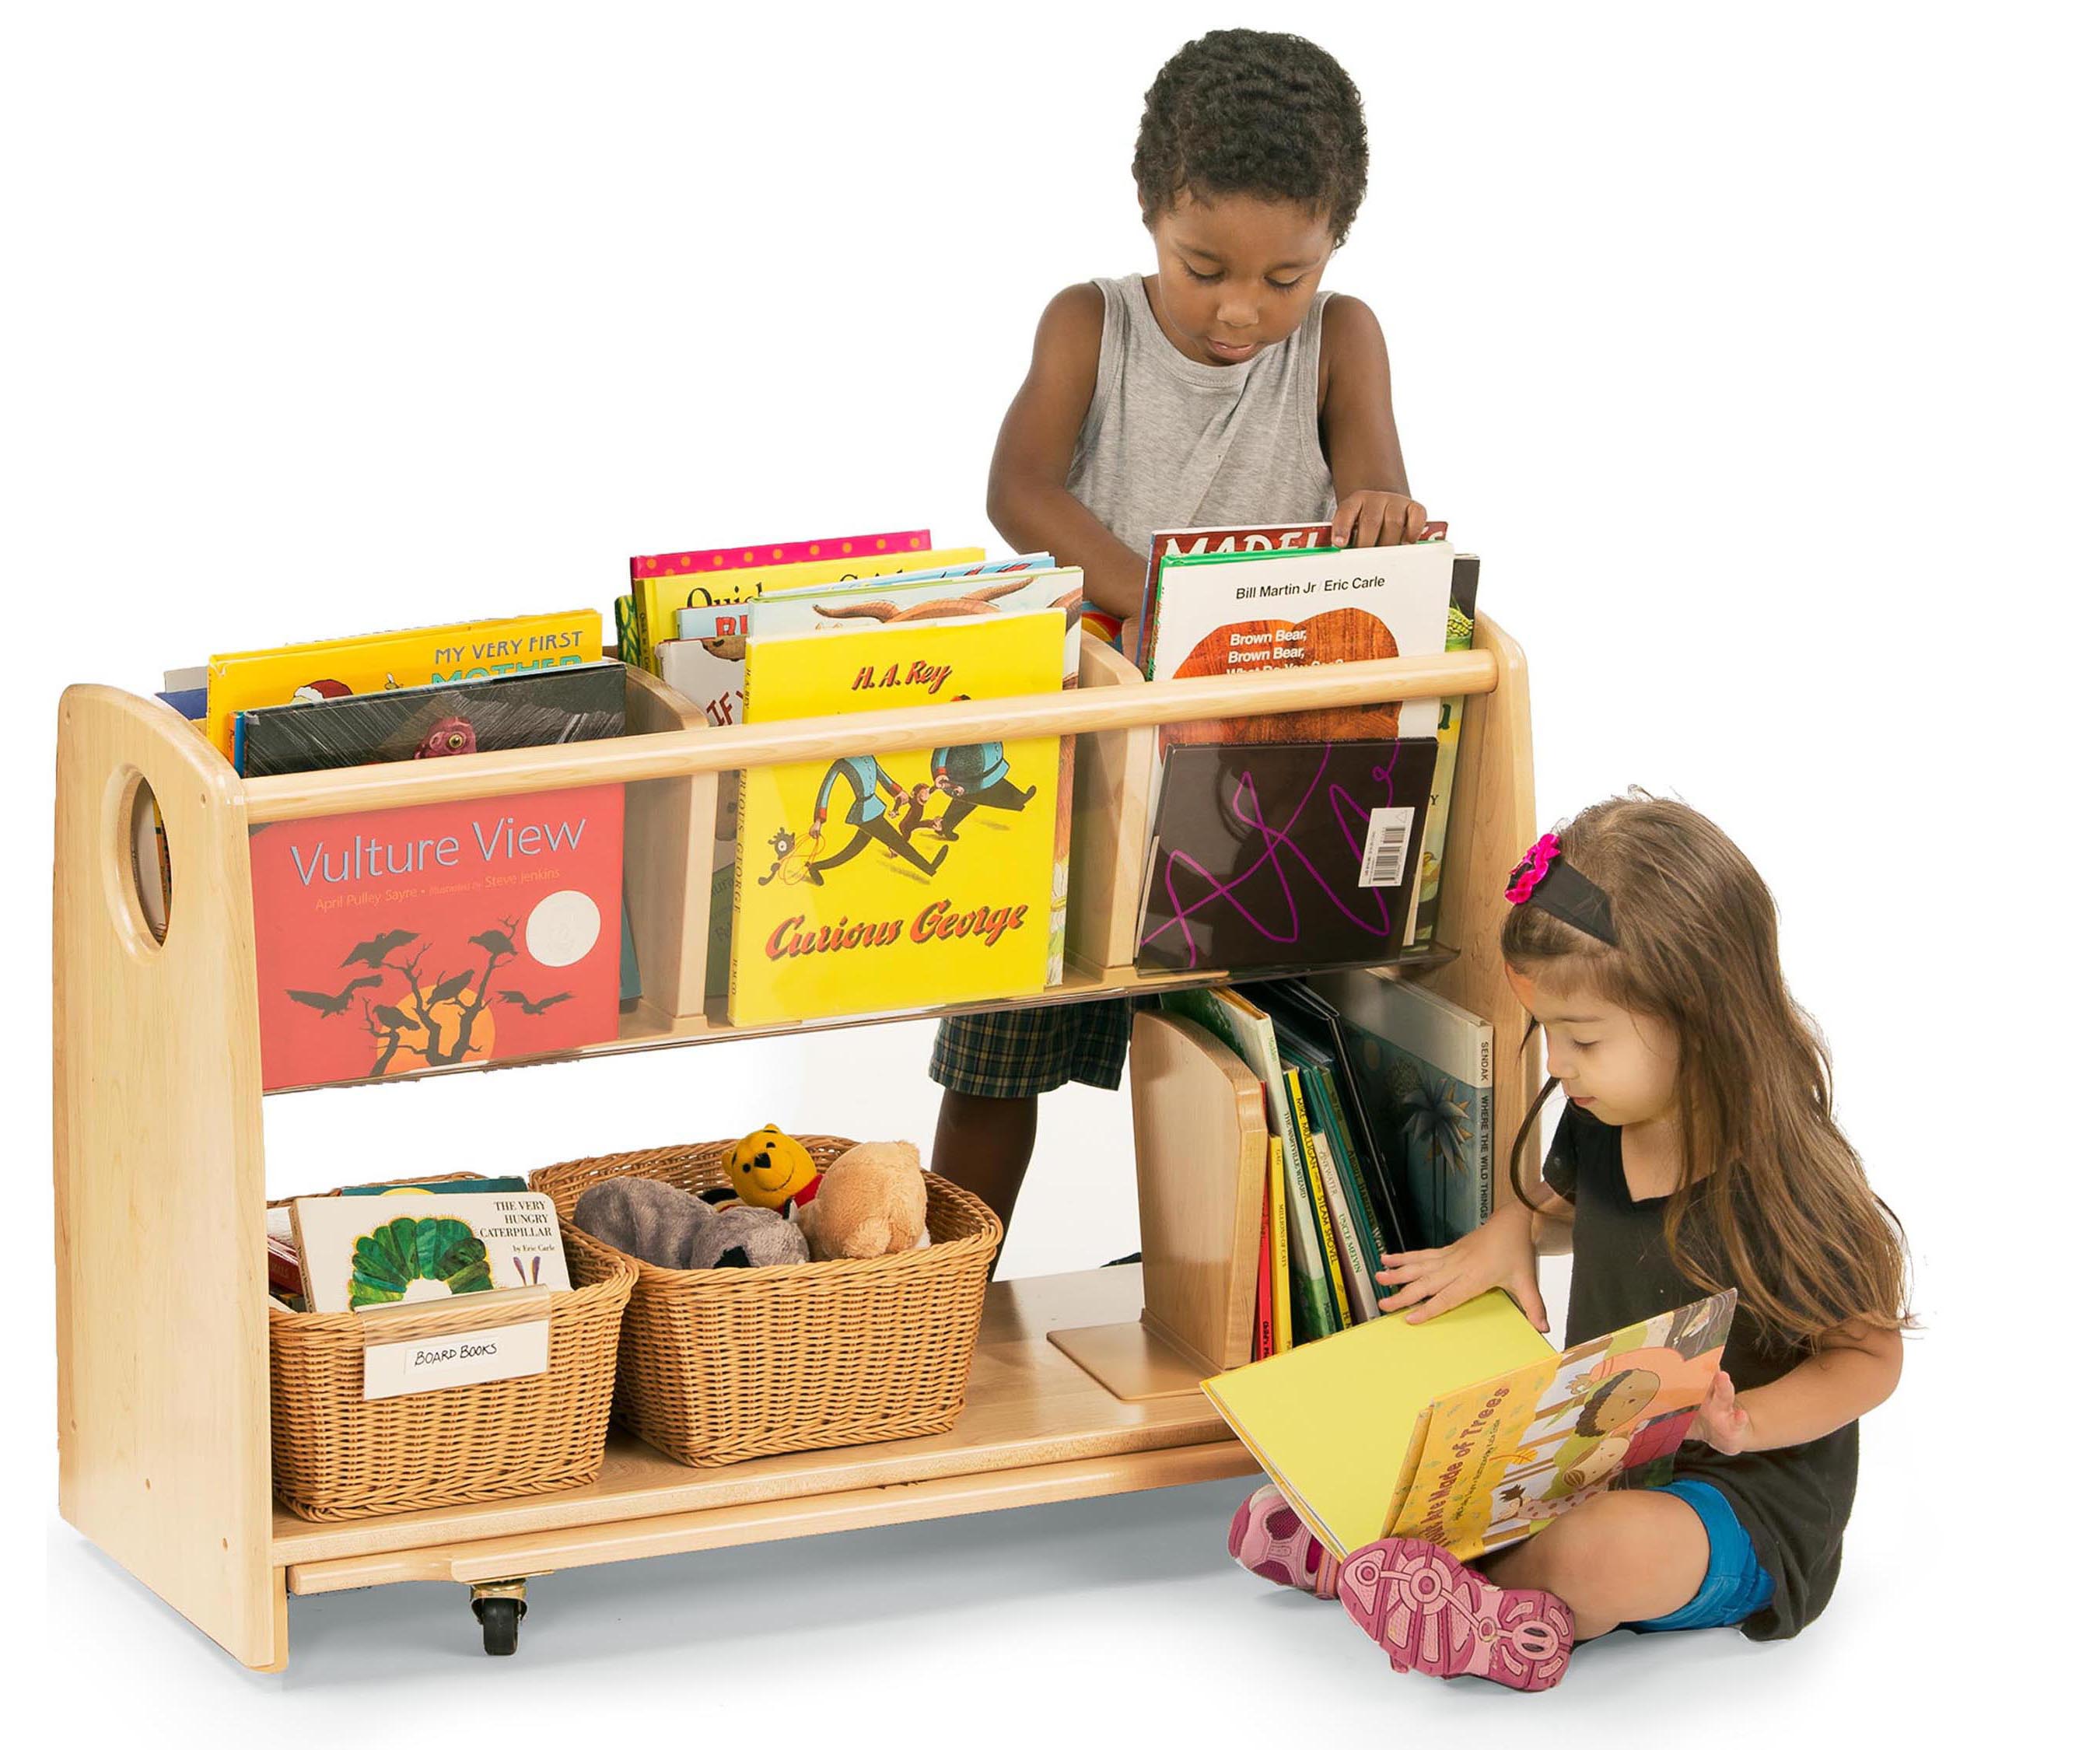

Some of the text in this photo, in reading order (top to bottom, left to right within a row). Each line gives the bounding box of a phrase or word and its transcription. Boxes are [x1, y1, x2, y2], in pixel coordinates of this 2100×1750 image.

[1236, 576, 1385, 600] Bill Martin Jr Eric Carle
[435, 631, 583, 664] MY VERY FIRST
[1230, 628, 1307, 646] Brown Bear,
[1228, 646, 1305, 663] Brown Bear,
[852, 660, 953, 695] H. A. Rey
[706, 691, 733, 726] IF
[738, 768, 748, 832] URIOUS
[290, 817, 587, 887] Vulture View
[316, 894, 343, 912] April
[346, 892, 381, 908] Pulley
[386, 887, 418, 903] Sayre
[485, 876, 516, 888] Steve
[520, 867, 561, 886] Jenkins
[765, 898, 1029, 962] Curious George
[1480, 1041, 1489, 1082] SENDAK
[1480, 1095, 1489, 1131] WHERE
[1297, 1097, 1318, 1170] MIKE MULLIGAN
[1480, 1133, 1489, 1153] THE
[1480, 1154, 1489, 1180] WILD
[1296, 1169, 1307, 1199] WIZARD
[494, 1200, 546, 1211] THE VERY
[1480, 1182, 1489, 1220] THINGS
[479, 1227, 552, 1238] CATERPILLAR
[504, 1213, 548, 1224] HUNGRY
[1318, 1195, 1328, 1227] STEAM
[1325, 1228, 1338, 1265] SHOVEL
[513, 1244, 522, 1253] by
[1347, 1242, 1362, 1274] MELVIN
[414, 1342, 498, 1367] BOARD BOOKS
[1459, 1388, 1510, 1438] Trees
[1451, 1441, 1475, 1458] of
[1428, 1461, 1464, 1503] Made
